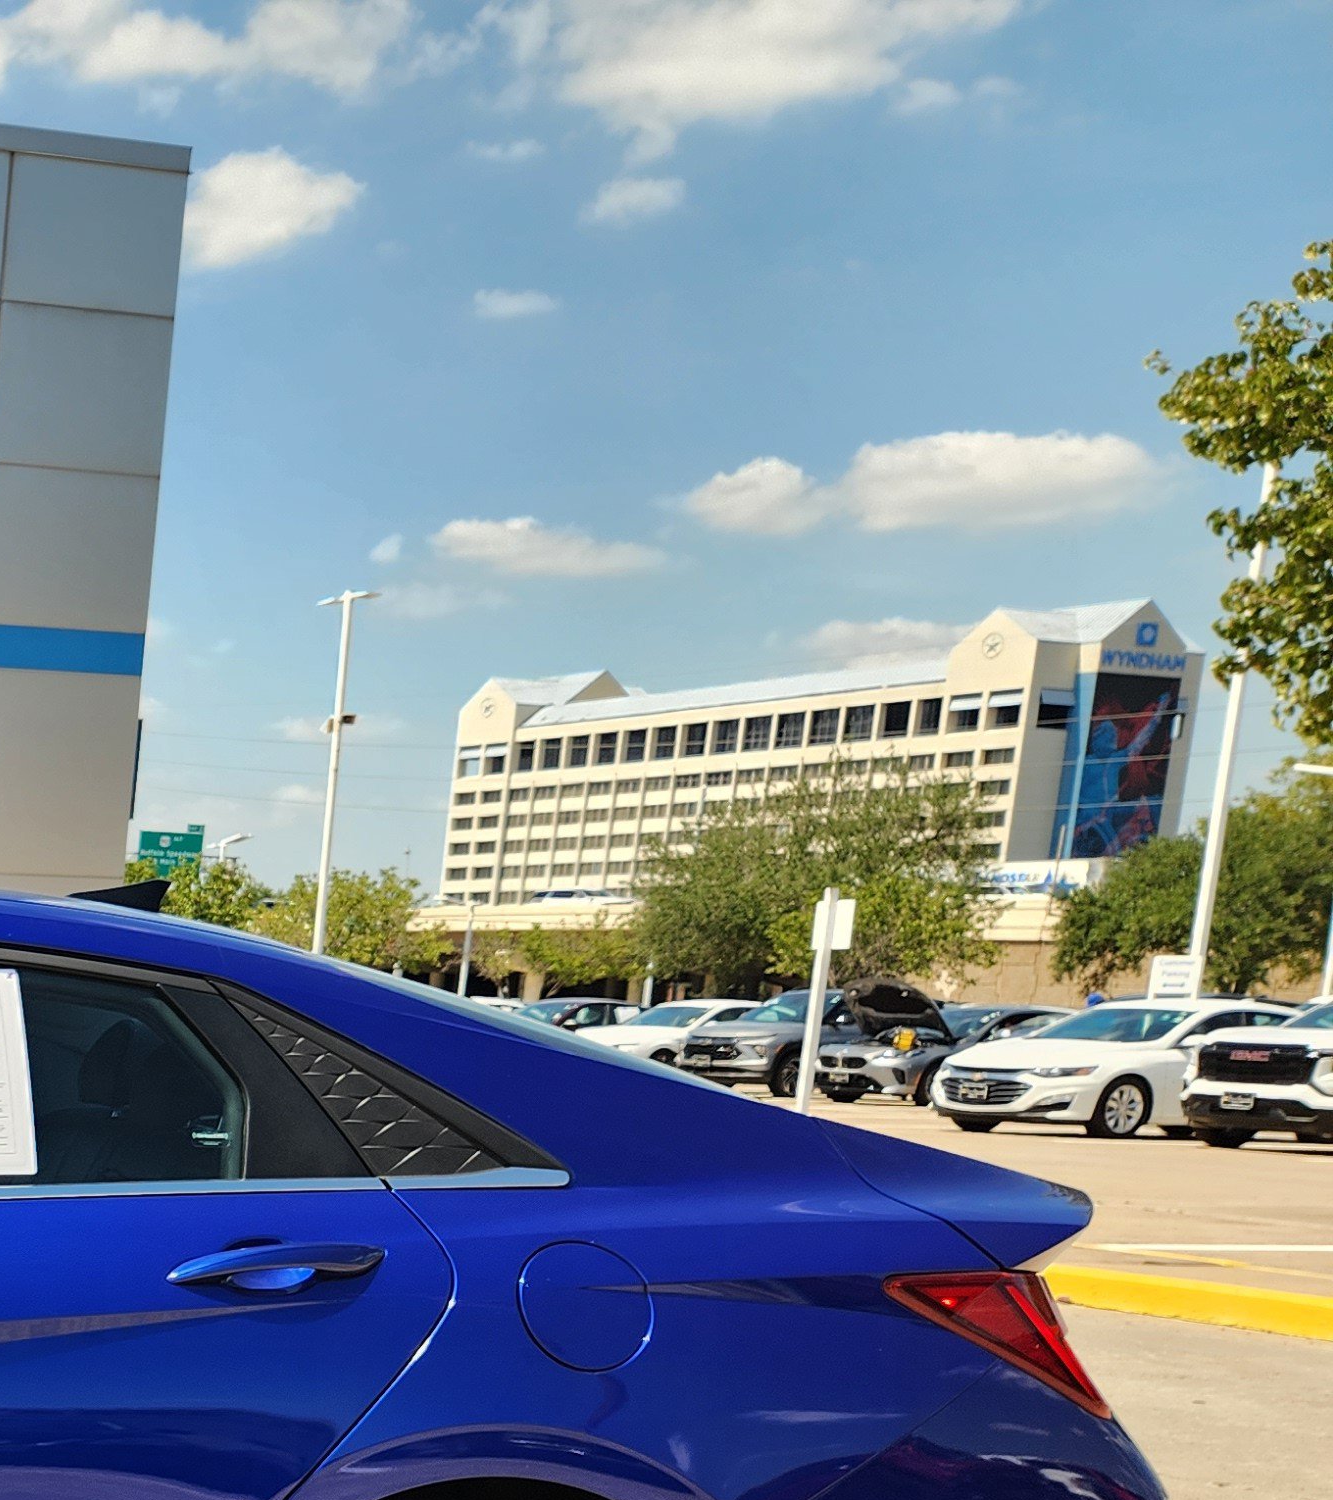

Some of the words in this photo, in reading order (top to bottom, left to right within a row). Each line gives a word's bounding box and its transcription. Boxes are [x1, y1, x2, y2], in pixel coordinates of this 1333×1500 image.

[1101, 649, 1187, 671] WYNDHAM
[1161, 970, 1190, 978] Parking
[1230, 1050, 1272, 1062] GMC
